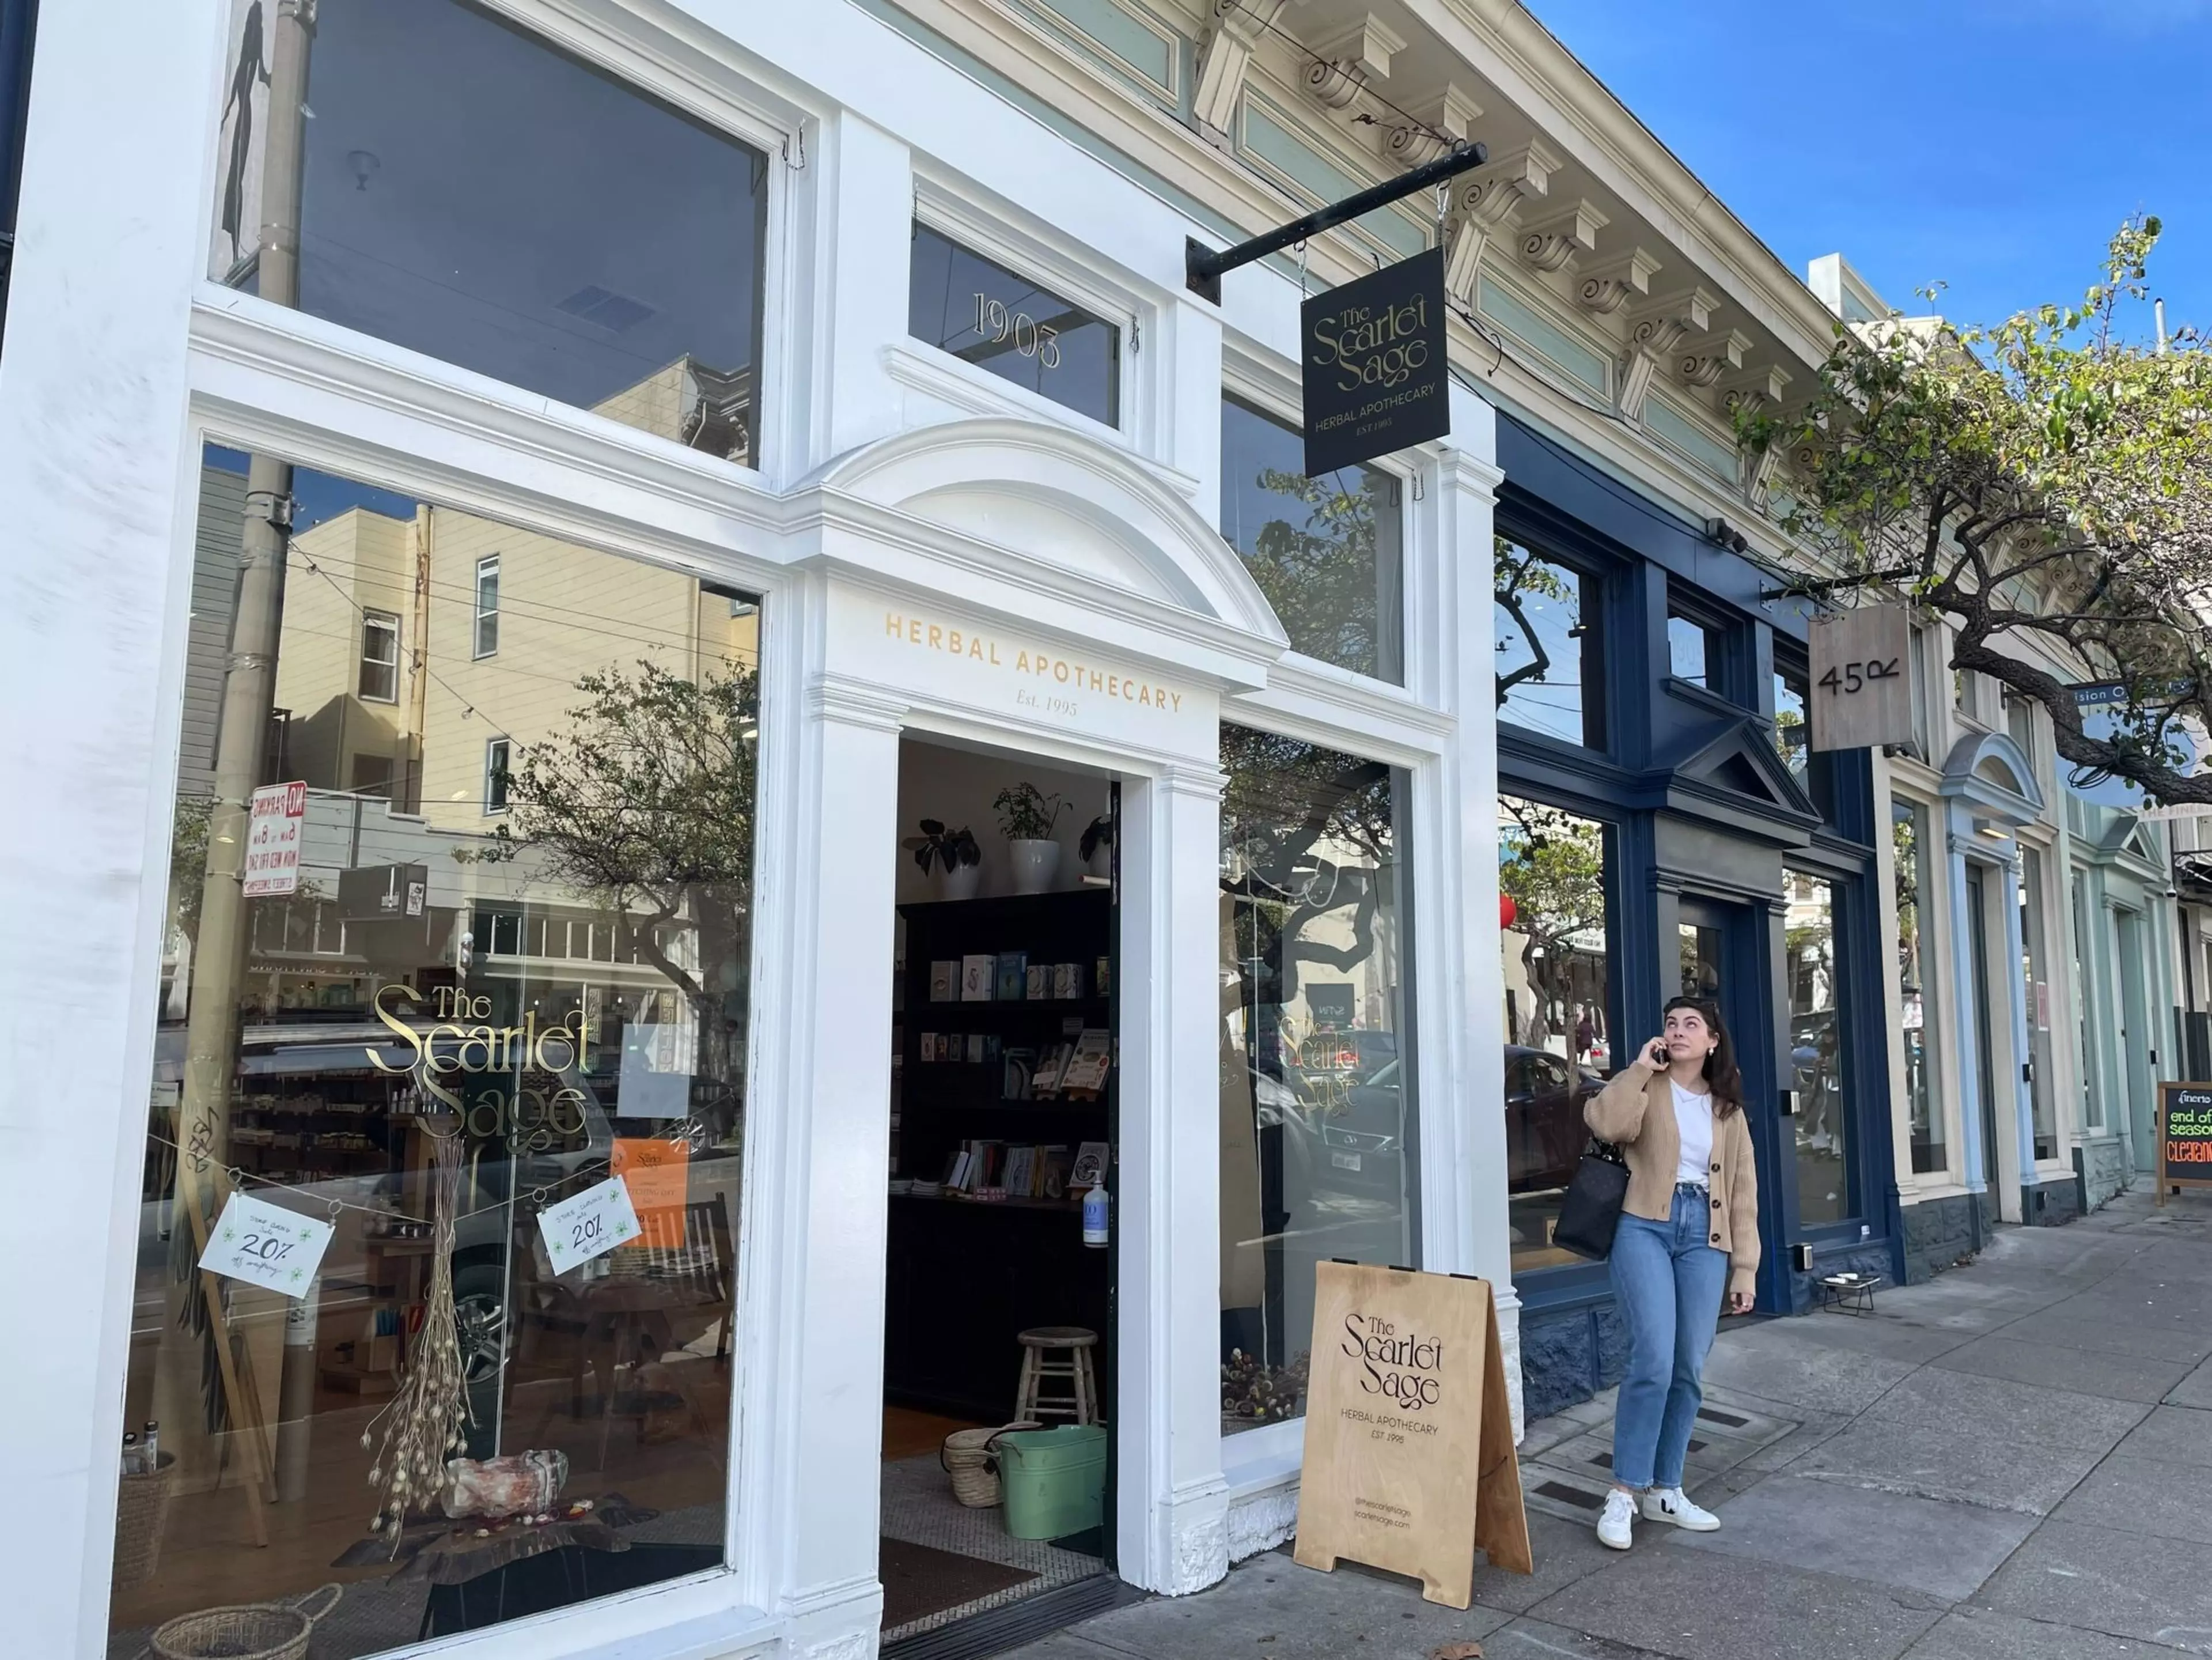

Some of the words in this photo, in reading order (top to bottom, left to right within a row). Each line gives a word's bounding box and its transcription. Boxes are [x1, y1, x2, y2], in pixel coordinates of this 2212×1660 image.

[974, 293, 1060, 368] 1903
[1312, 293, 1428, 365] Scarlet
[1339, 307, 1370, 328] The
[1338, 339, 1428, 391] Sage
[1316, 410, 1357, 433] HERBAL
[1359, 383, 1435, 418] APOTHECARY
[885, 612, 1001, 666] HERBAL
[1016, 651, 1182, 713] APOTHECARY
[1016, 689, 1039, 709] Est.
[1046, 696, 1079, 717] 1995
[2074, 691, 2107, 702] ision
[432, 986, 492, 1019] The
[366, 984, 593, 1073] Scarlet
[1279, 1016, 1359, 1069] Scarlet
[1303, 1017, 1321, 1037] The
[415, 1055, 587, 1154] Sage
[1298, 1069, 1359, 1117] Sage
[2170, 1108, 2194, 1123] end
[2198, 1109, 2212, 1124] of
[239, 1234, 296, 1261] 20%
[572, 1213, 603, 1249] 20%
[1341, 1313, 1444, 1372] Scarlet
[1369, 1316, 1395, 1336] The
[1359, 1351, 1440, 1411] Sage
[1340, 1408, 1374, 1424] HERBAL
[1377, 1415, 1439, 1436] APOTHECARY
[1387, 1432, 1405, 1444] 1995
